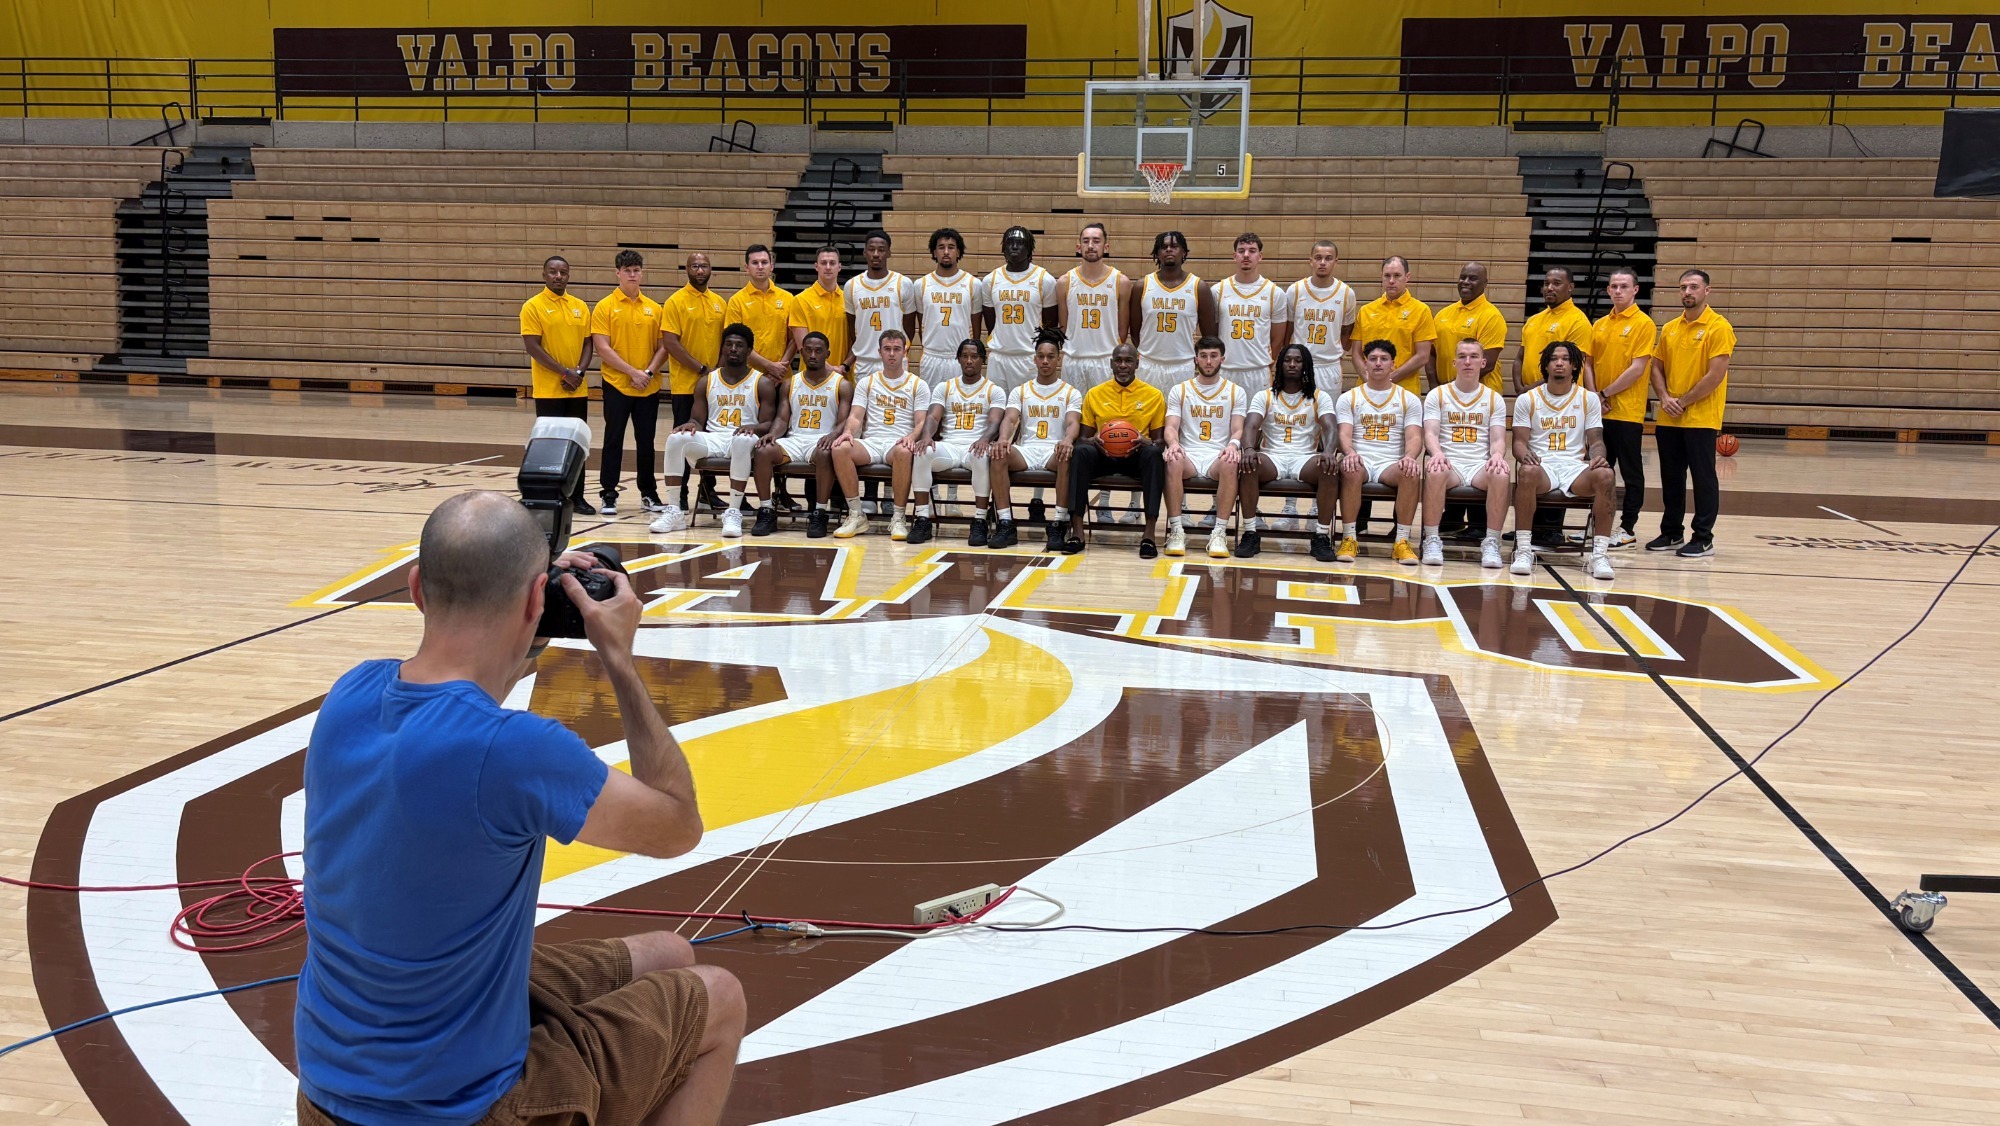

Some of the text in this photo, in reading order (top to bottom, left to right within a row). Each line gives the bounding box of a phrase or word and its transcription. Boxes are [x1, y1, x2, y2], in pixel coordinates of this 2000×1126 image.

[397, 32, 892, 93] VALPO BEACONS
[1563, 23, 1790, 88] VALPO
[1218, 164, 1225, 176] 5
[859, 295, 890, 309] VALPO
[931, 291, 963, 304] VALPO
[998, 289, 1030, 302] VALPO
[1077, 293, 1108, 306] VALPO
[1151, 297, 1185, 310] VALPO
[940, 306, 952, 326] 7
[1002, 304, 1025, 324] 23
[1081, 308, 1101, 329] 13
[1228, 304, 1261, 318] VALPO
[1303, 308, 1335, 322] VALPO
[869, 311, 882, 331] 4
[1156, 312, 1177, 332] 15
[1230, 319, 1254, 340] 35
[1307, 323, 1328, 345] 12
[716, 394, 746, 407] VALPO
[797, 394, 828, 408] VALPO
[716, 408, 742, 427] 44
[798, 409, 821, 429] 22
[883, 408, 895, 426] 5
[1028, 404, 1060, 417] VALPO
[1190, 404, 1223, 418] VALPO
[1273, 412, 1307, 426] VALPO
[955, 413, 975, 430] 10
[1036, 420, 1048, 439] 0
[1540, 415, 1576, 431] VALPO
[1199, 420, 1212, 441] 3
[1283, 427, 1292, 443] 1
[1548, 432, 1567, 451] 11
